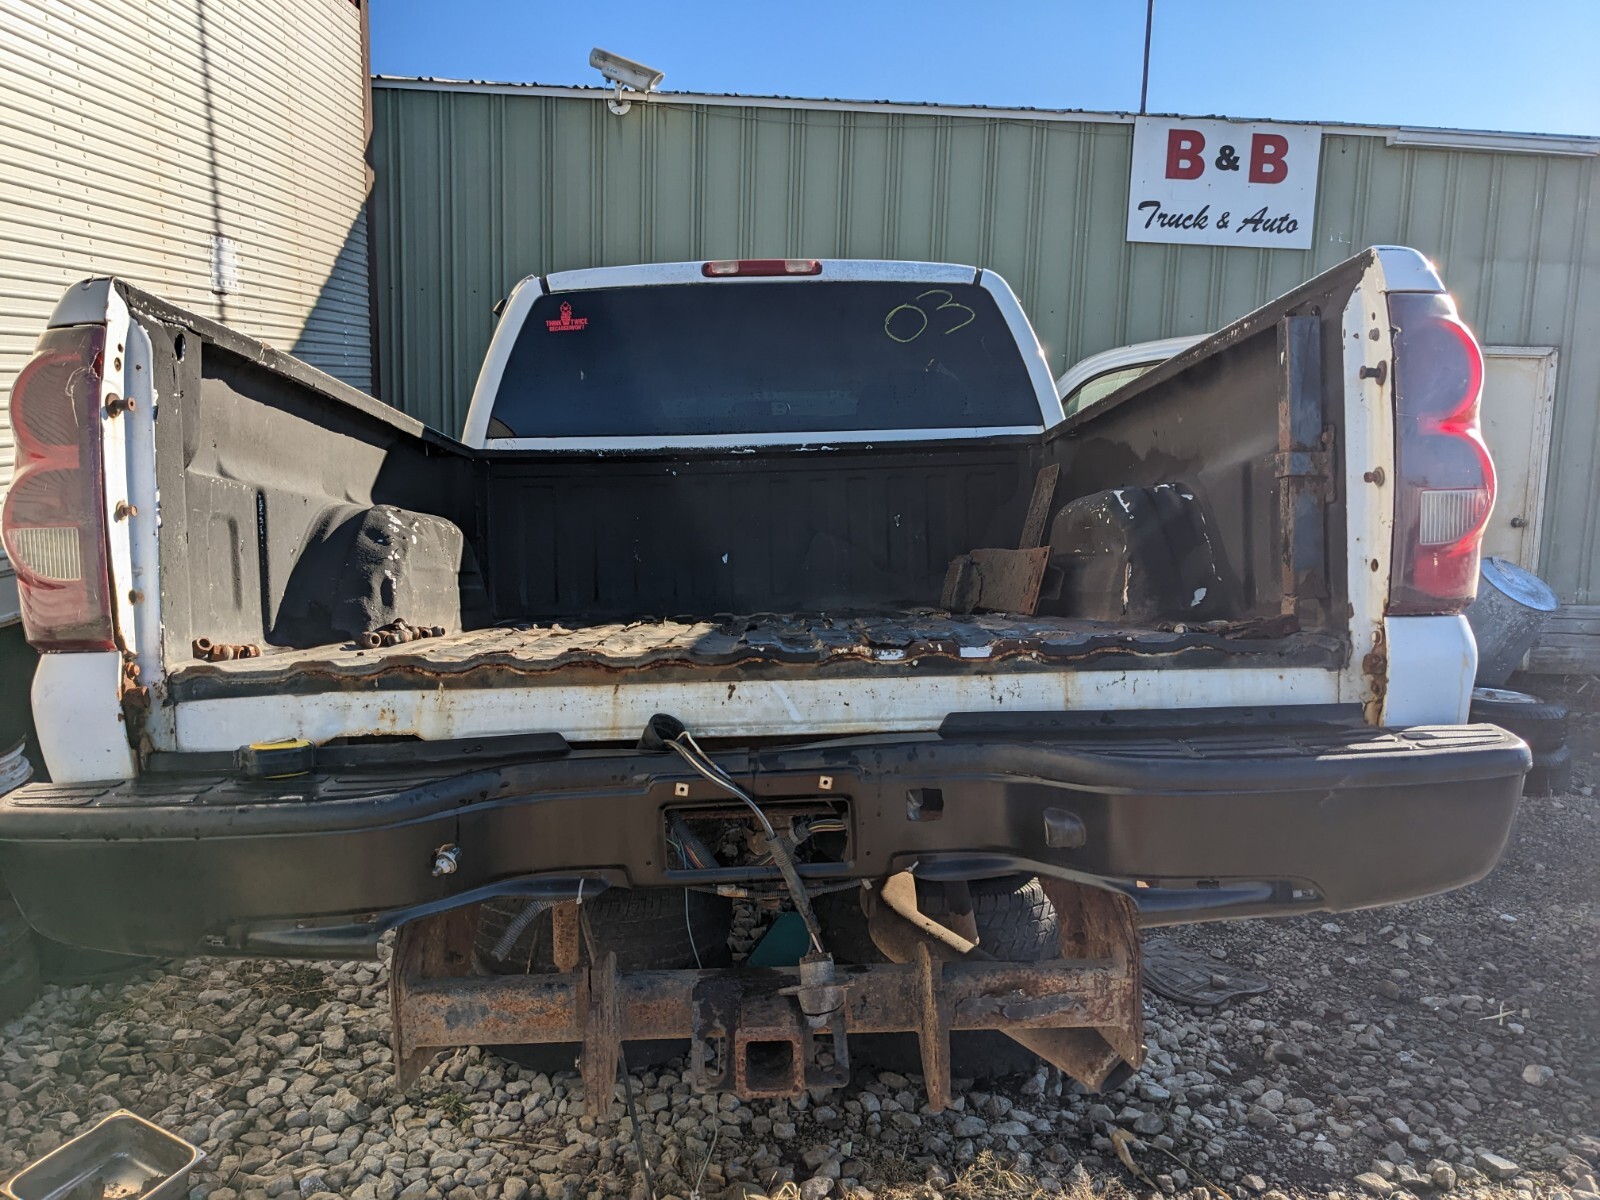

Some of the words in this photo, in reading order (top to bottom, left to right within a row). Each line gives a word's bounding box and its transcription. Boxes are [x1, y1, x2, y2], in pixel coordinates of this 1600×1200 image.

[1165, 129, 1206, 180] B
[1215, 145, 1240, 171] &
[1248, 133, 1289, 184] B
[1137, 200, 1210, 230] Truck
[1216, 211, 1230, 230] &
[1235, 206, 1299, 234] Auto
[885, 290, 976, 343] 03
